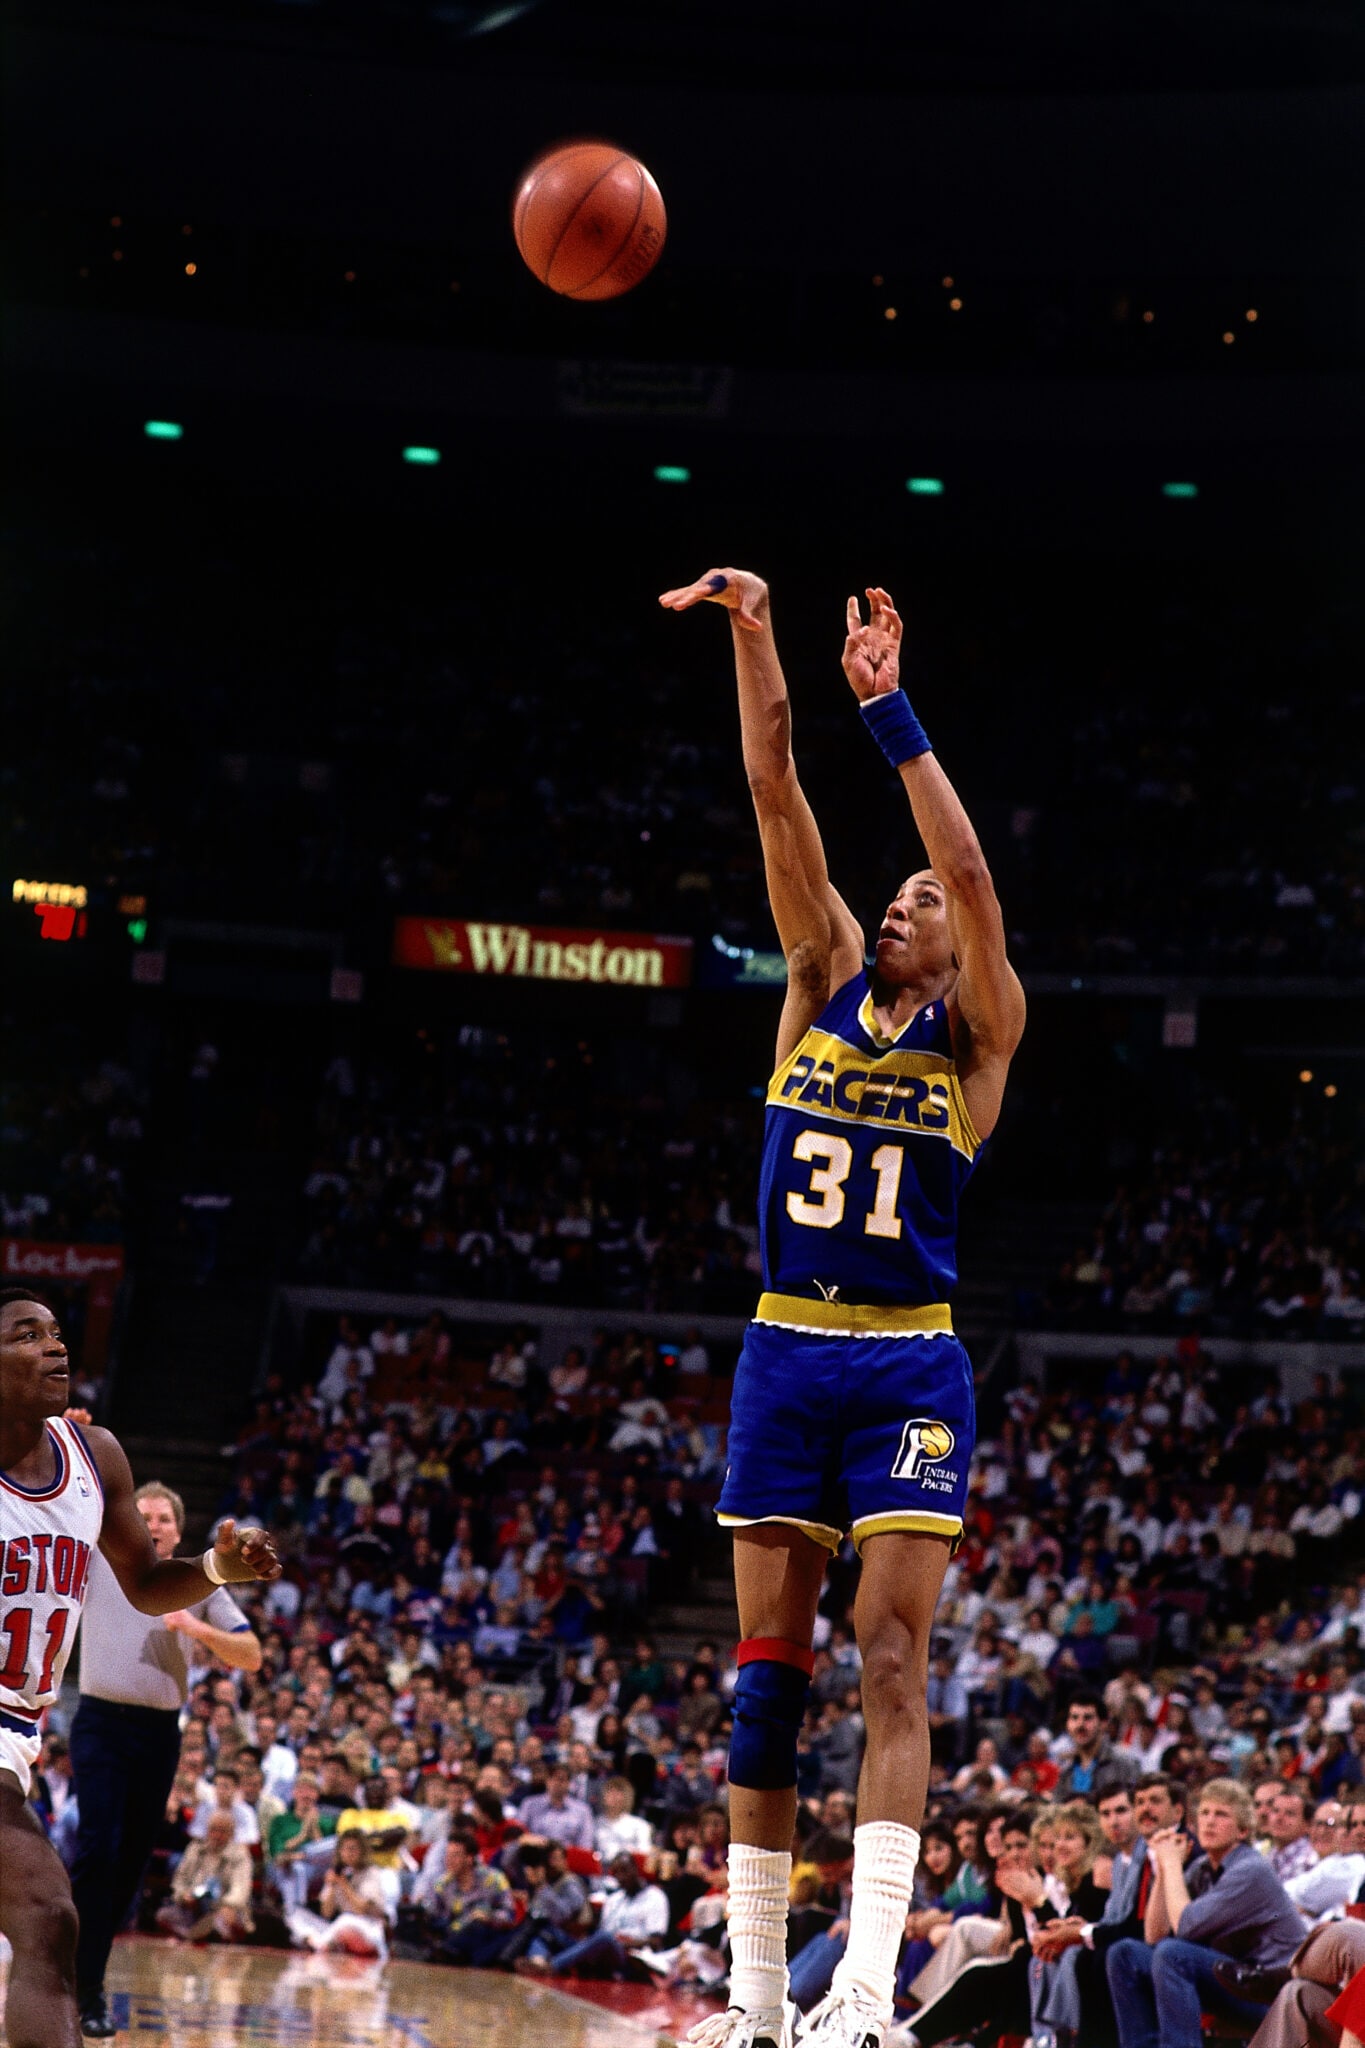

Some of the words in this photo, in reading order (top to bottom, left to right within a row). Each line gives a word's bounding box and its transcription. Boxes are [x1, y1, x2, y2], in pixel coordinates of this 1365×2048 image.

[467, 924, 662, 986] Winston
[782, 1056, 949, 1129] PACERS
[786, 1130, 904, 1239] 31
[0, 1534, 91, 1606] STON
[0, 1608, 69, 1695] 11
